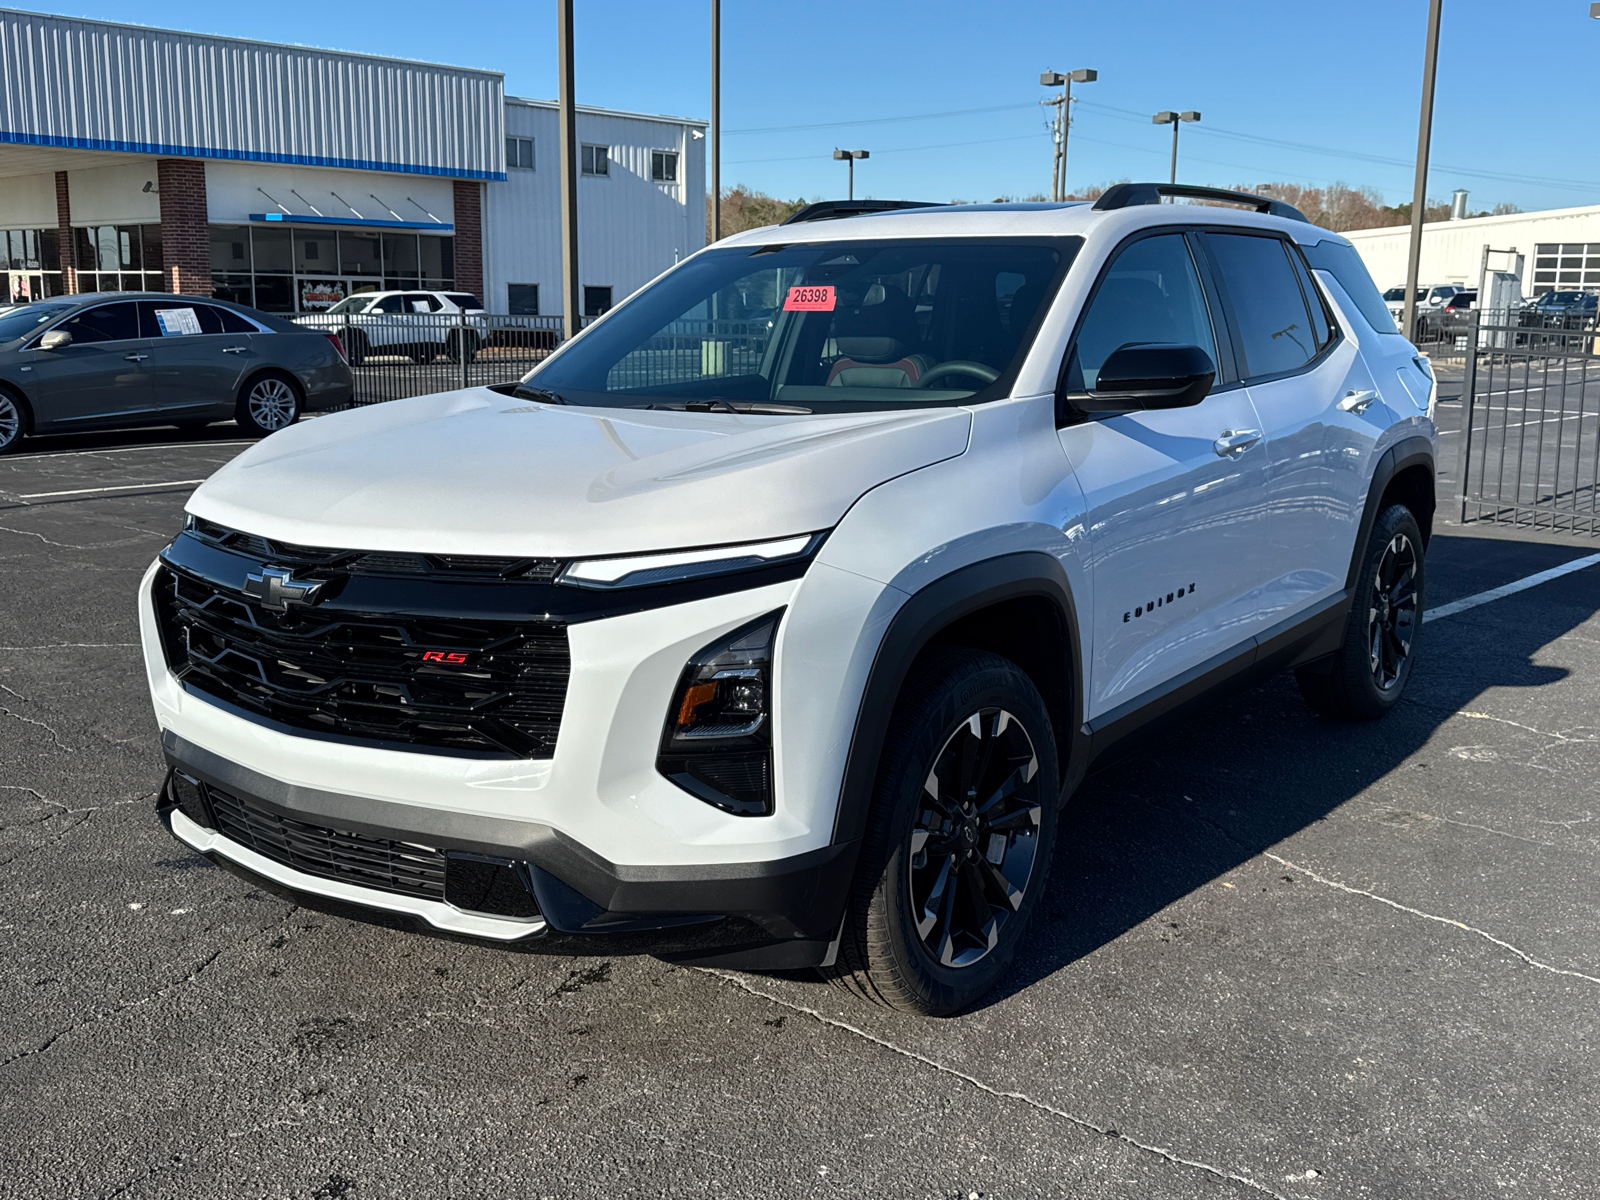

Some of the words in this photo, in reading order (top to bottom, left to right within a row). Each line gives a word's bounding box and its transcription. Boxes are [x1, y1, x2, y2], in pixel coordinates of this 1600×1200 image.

[793, 289, 828, 303] 26398
[1122, 583, 1196, 623] EQUINOX
[422, 651, 469, 663] RS
